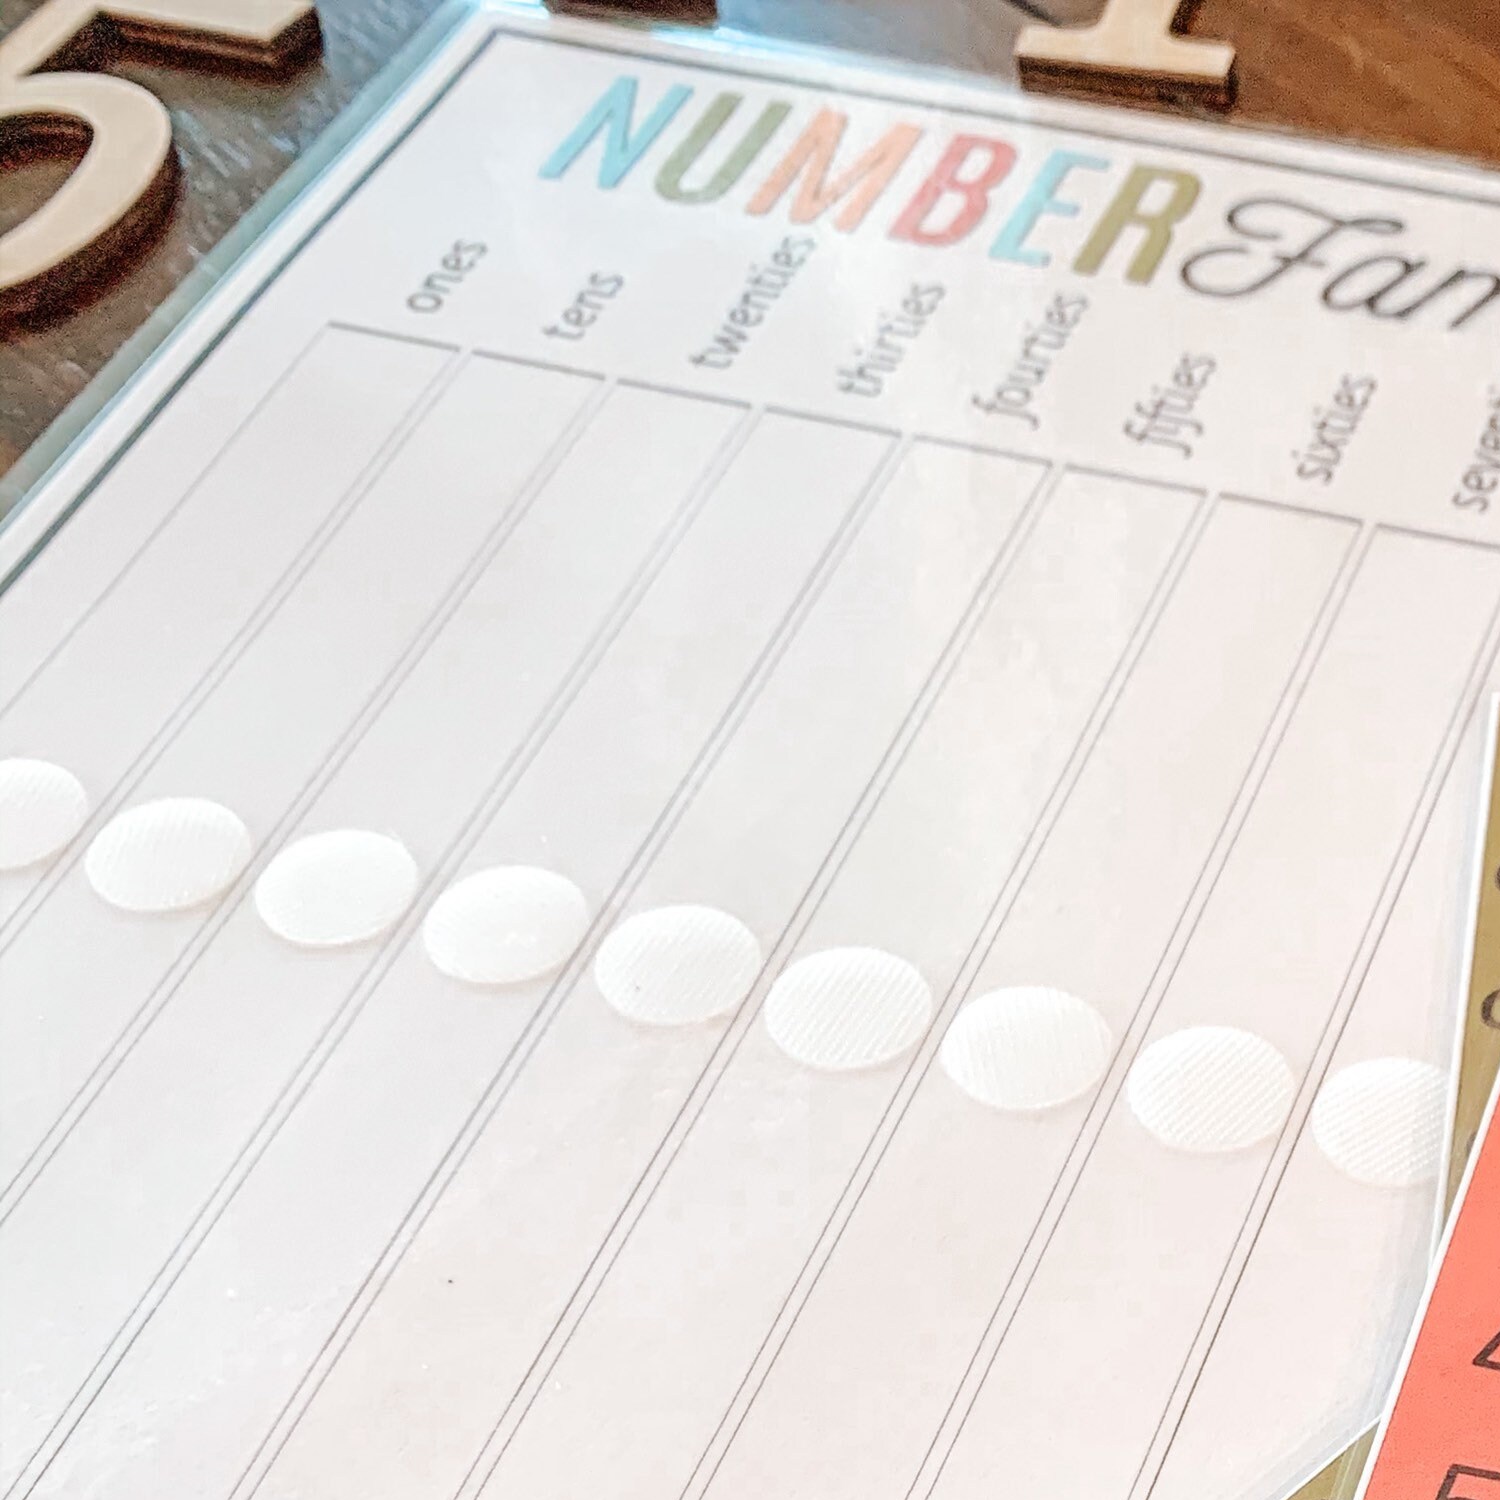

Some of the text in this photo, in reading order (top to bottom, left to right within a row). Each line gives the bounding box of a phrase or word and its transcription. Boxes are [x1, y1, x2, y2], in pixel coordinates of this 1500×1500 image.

[538, 74, 1204, 287] NUMBER
[407, 236, 488, 314] ones
[541, 269, 626, 343] tens
[690, 228, 819, 371] twenties
[837, 278, 946, 399] thirties
[972, 292, 1092, 430] fourties
[1124, 353, 1217, 459] fifties
[1297, 373, 1378, 487] sixties
